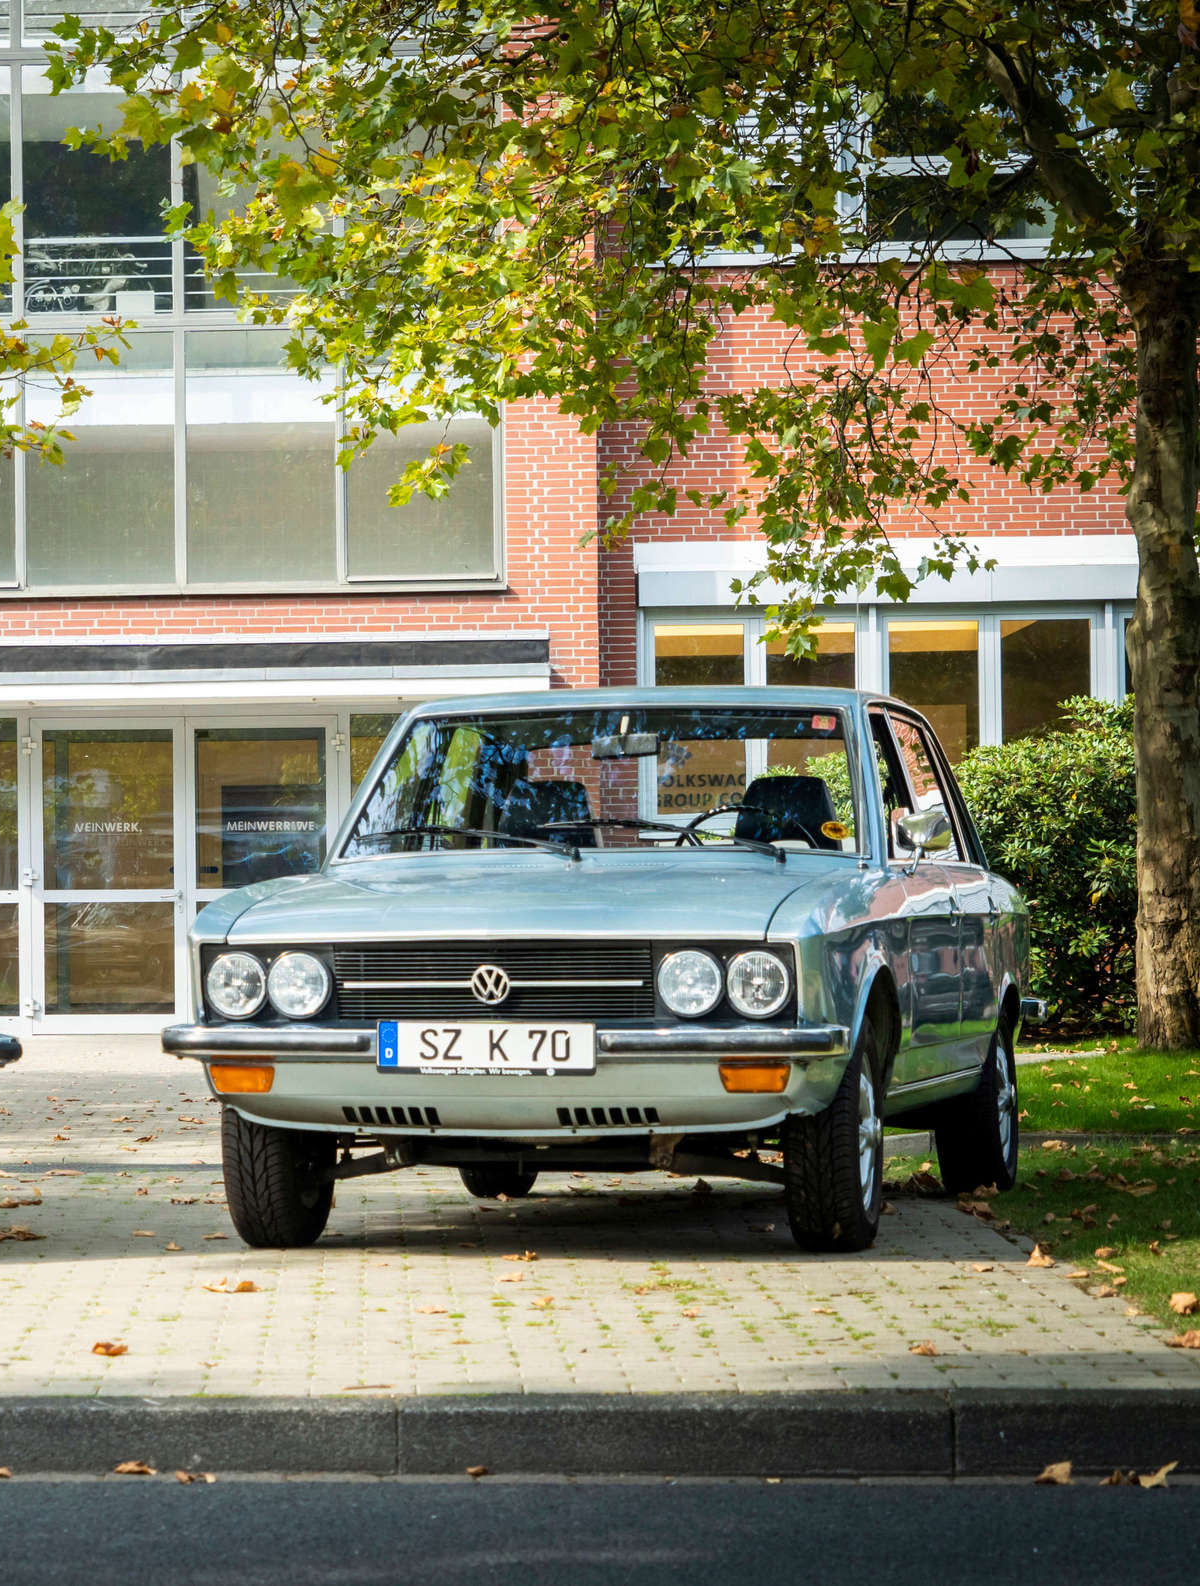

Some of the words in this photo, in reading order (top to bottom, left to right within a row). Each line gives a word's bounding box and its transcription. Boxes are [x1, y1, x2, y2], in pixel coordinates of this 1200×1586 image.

[657, 793, 712, 807] ROUP
[472, 965, 510, 1005] VW
[384, 1048, 393, 1059] D
[419, 1028, 463, 1061] SZ
[489, 1028, 509, 1062] K
[528, 1029, 571, 1062] 70
